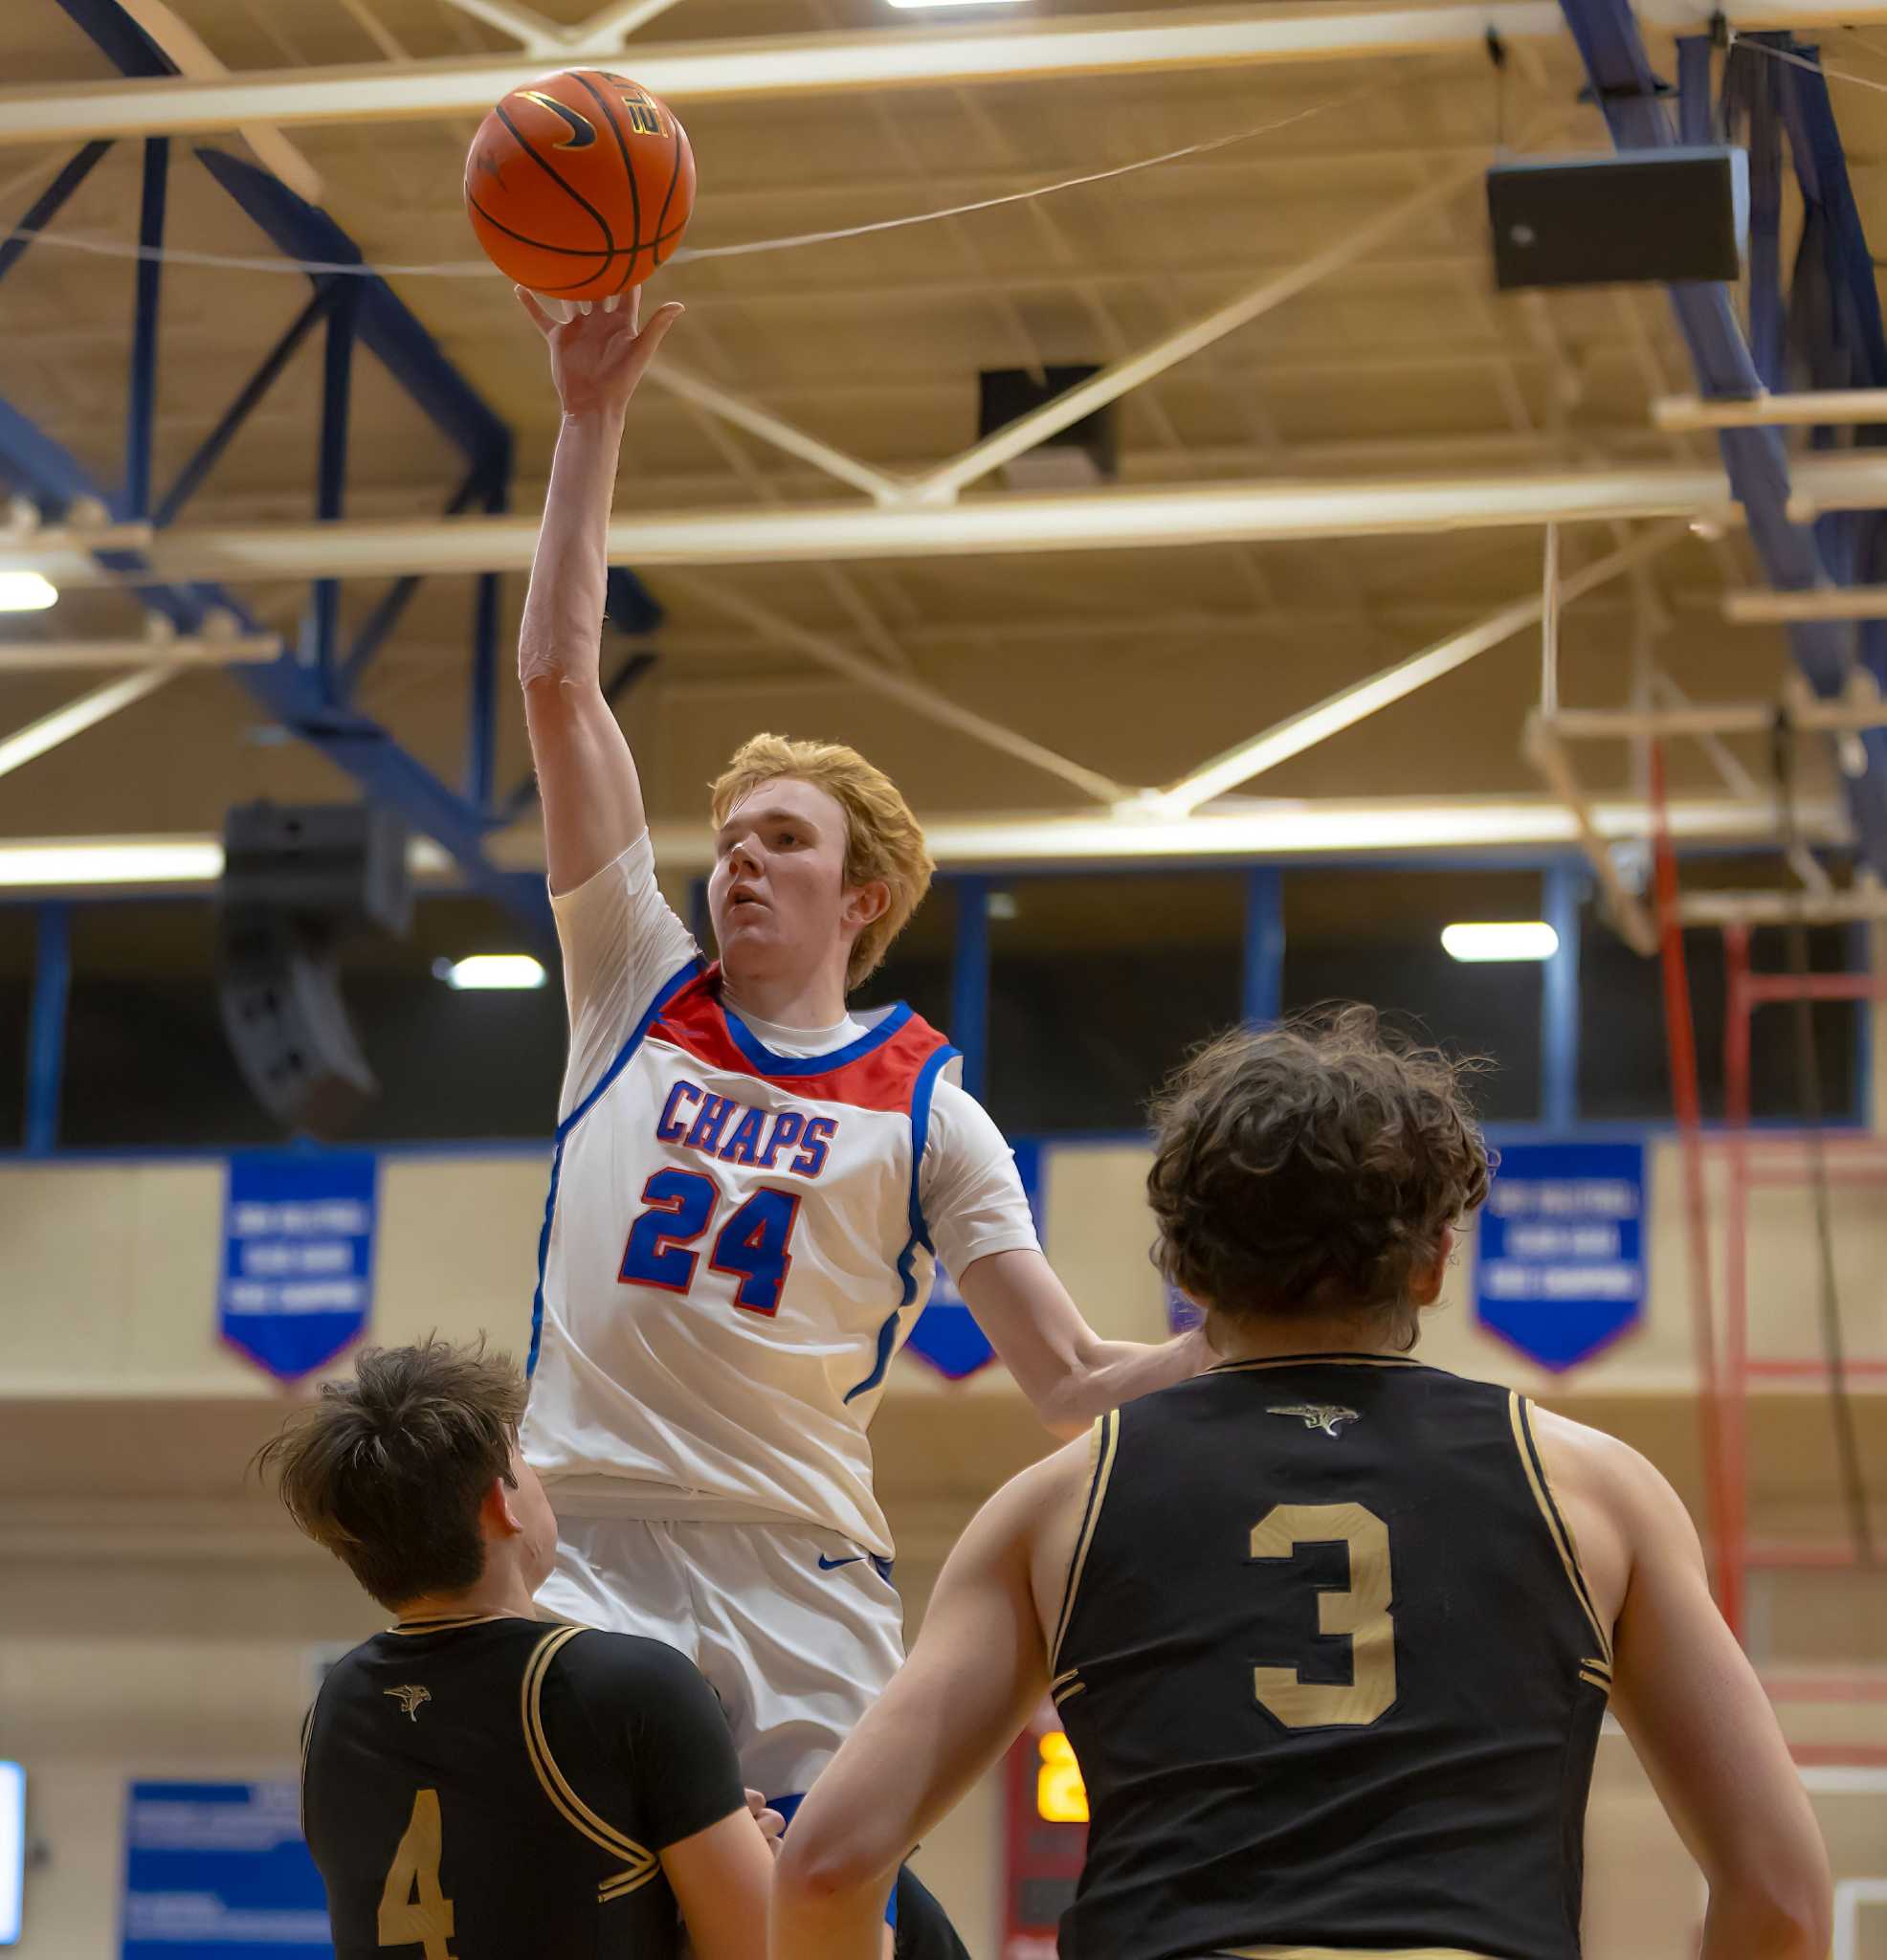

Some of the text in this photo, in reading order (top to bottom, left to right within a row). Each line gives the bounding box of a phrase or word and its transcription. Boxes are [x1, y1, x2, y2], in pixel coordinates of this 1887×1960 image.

[656, 1080, 839, 1179] CHAPS
[618, 1167, 802, 1318] 24
[1250, 1502, 1397, 1728] 3
[377, 1789, 459, 1960] 4
